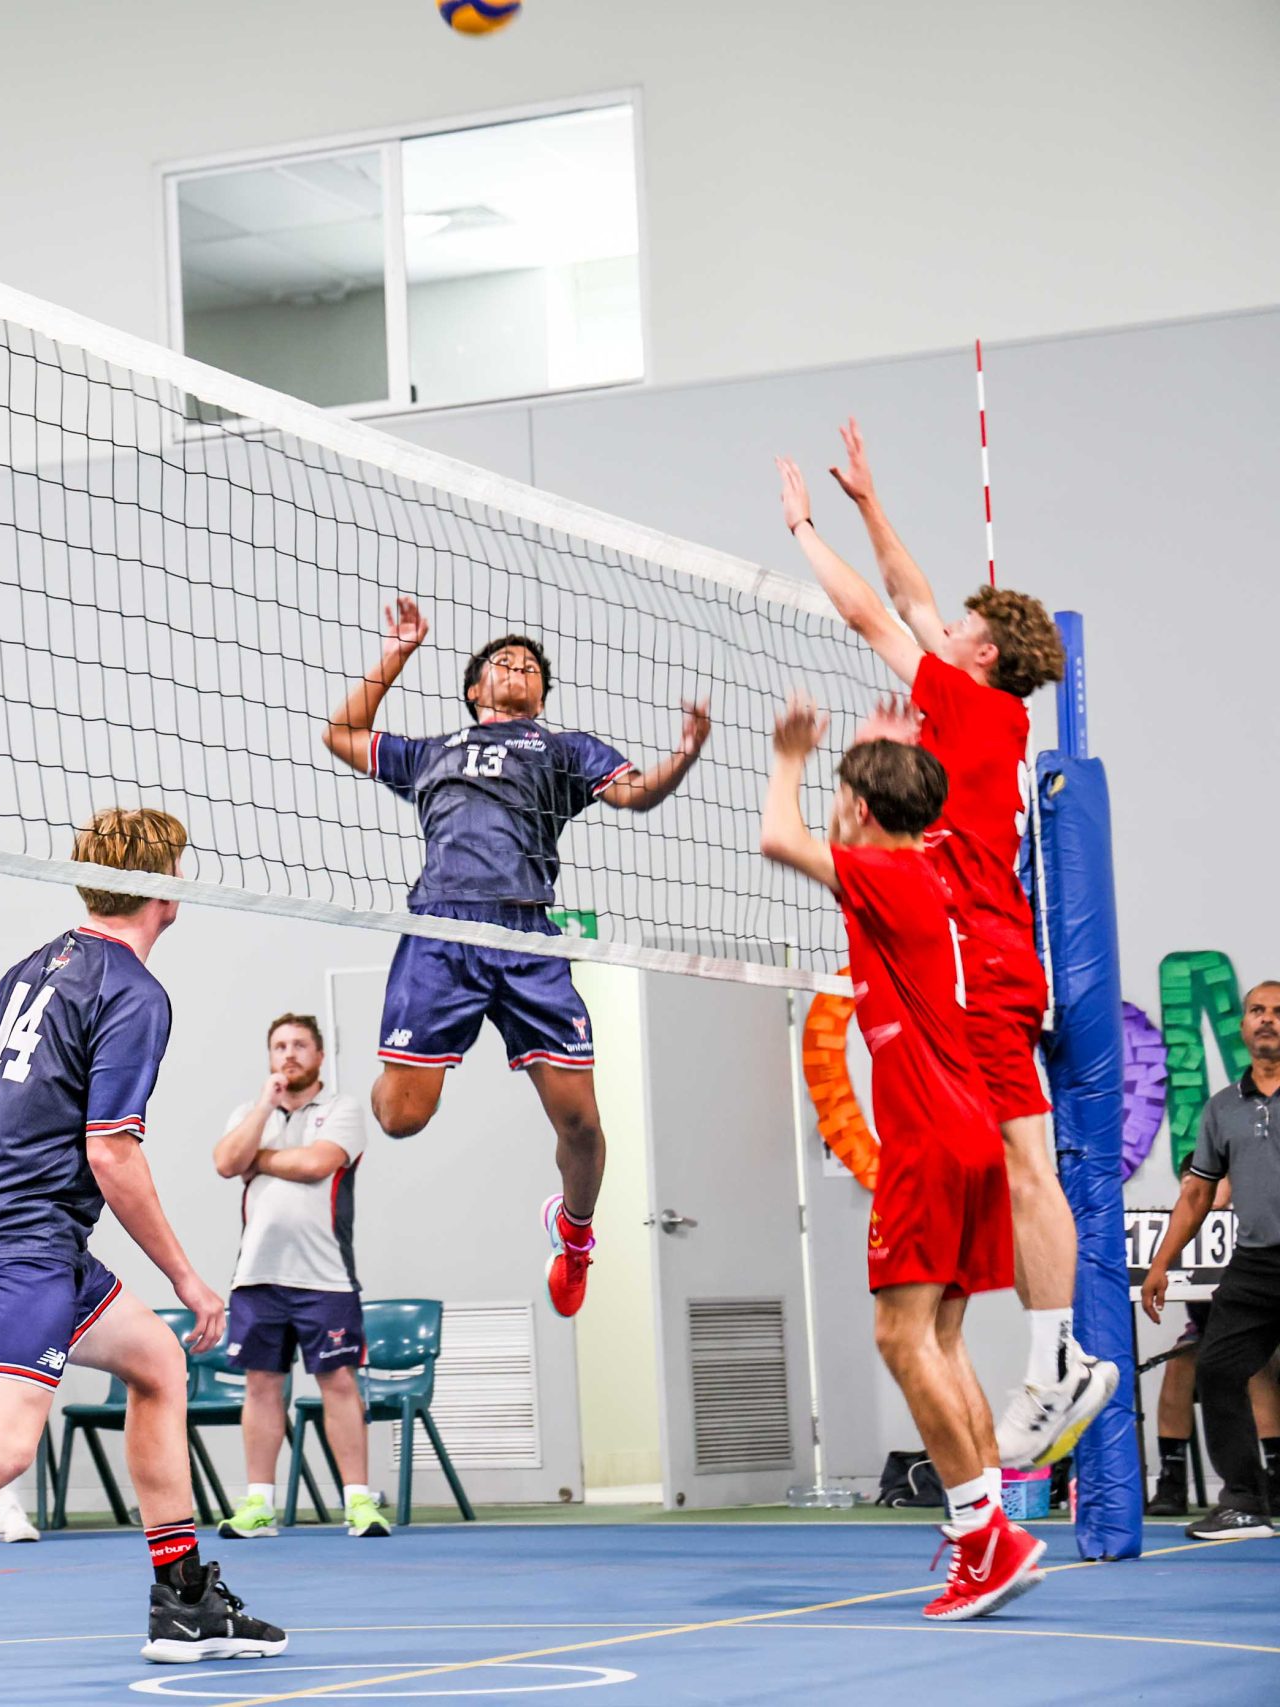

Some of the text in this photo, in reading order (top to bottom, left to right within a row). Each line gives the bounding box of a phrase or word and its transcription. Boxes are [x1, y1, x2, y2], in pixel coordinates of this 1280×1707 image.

[462, 743, 508, 777] 13
[1124, 1220, 1163, 1266] 17
[1194, 1219, 1226, 1265] 13
[150, 1544, 192, 1558] terbury
